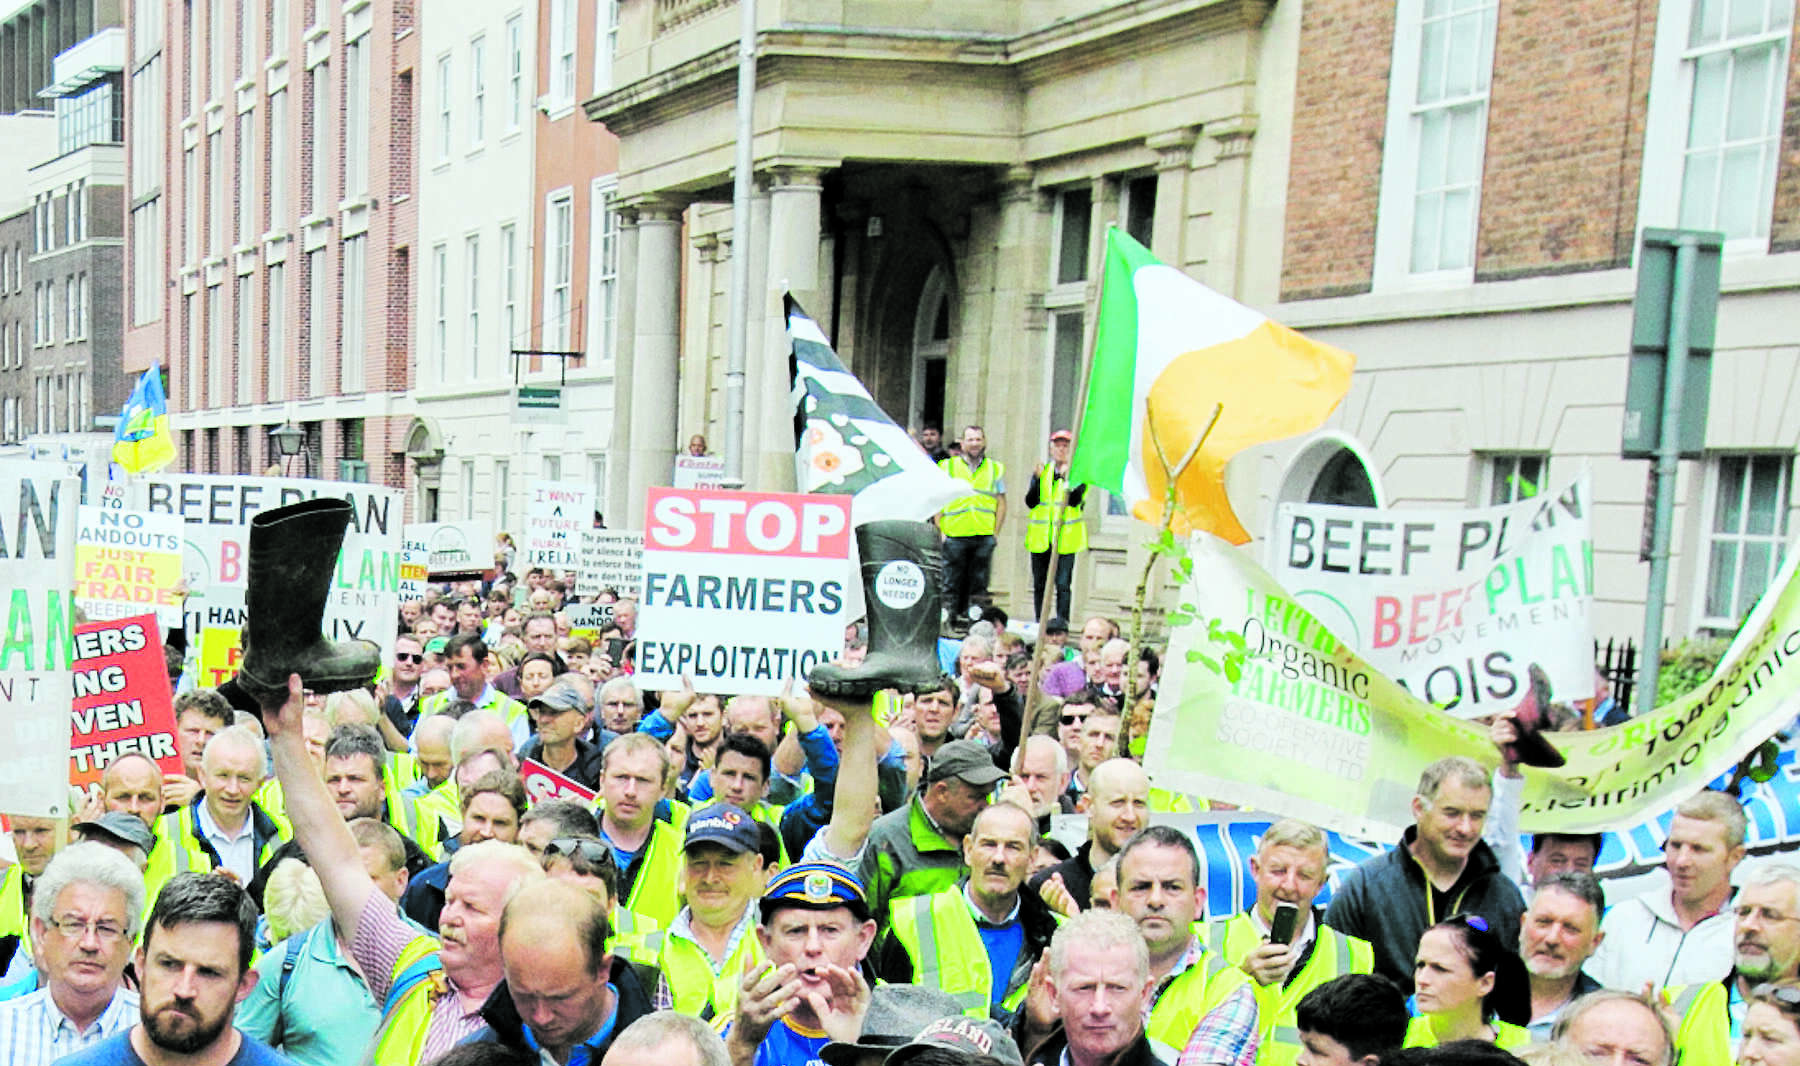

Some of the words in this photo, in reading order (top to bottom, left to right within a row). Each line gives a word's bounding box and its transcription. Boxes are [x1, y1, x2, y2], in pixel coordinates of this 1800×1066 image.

[549, 491, 586, 505] WANT
[100, 511, 144, 529] NO
[531, 517, 581, 531] FUTURE
[651, 495, 846, 554] STOP
[80, 527, 179, 550] ANDOUTS
[1288, 515, 1435, 576] BEEF
[95, 548, 147, 563] JUST
[85, 561, 156, 585] FAIR
[336, 547, 400, 593] LAN
[896, 564, 909, 574] NO
[74, 580, 176, 606] TRADE
[645, 571, 844, 616] FARMERS
[1243, 618, 1369, 700] Organic
[689, 816, 735, 833] glanbia
